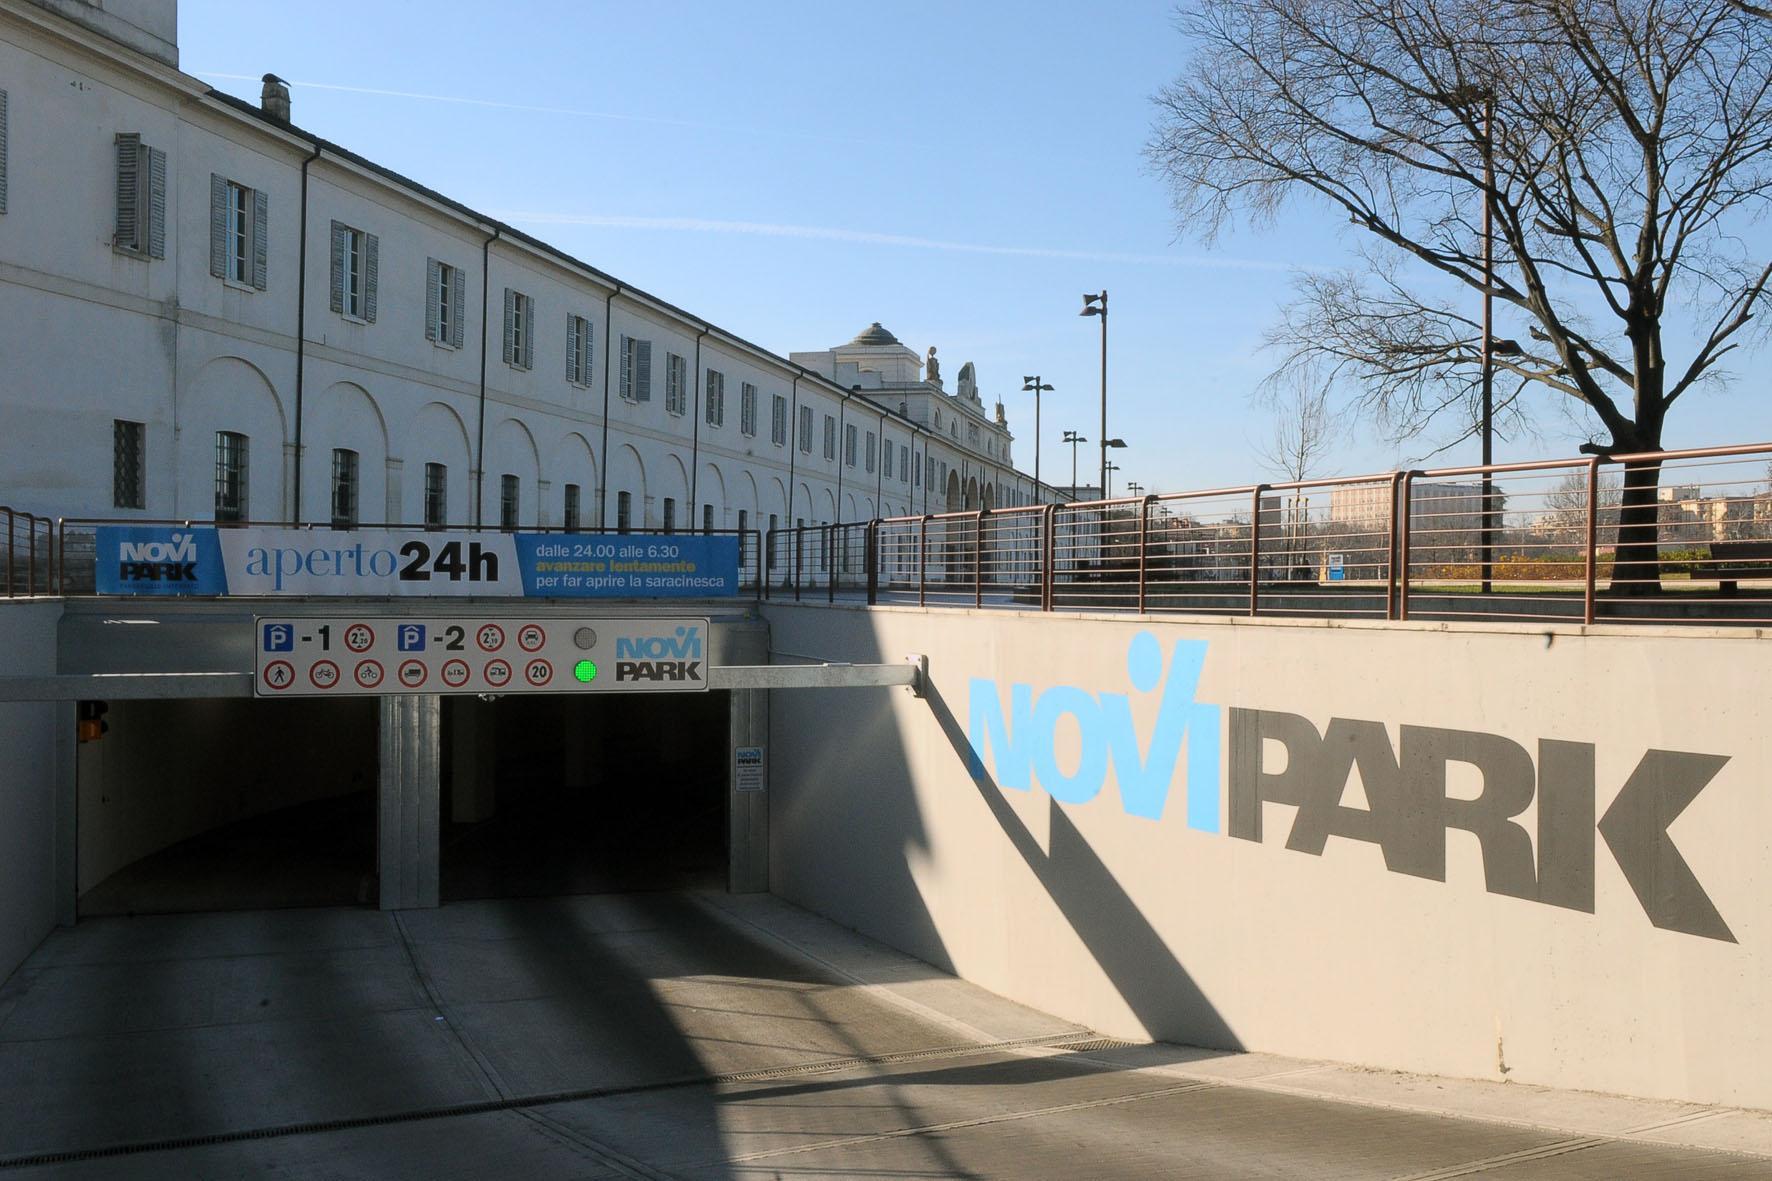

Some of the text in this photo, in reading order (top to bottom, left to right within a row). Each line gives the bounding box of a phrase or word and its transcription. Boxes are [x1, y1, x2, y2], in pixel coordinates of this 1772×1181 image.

[119, 533, 197, 561] NOVI
[536, 544, 679, 558] dalle 24.00 alle 6.30
[119, 562, 198, 581] PARK
[245, 541, 499, 591] aperto 24h
[536, 560, 697, 573] avanzare lentamente
[536, 574, 725, 589] per far aprire la saracinesca
[615, 626, 701, 659] NOVI
[532, 665, 548, 679] 20
[615, 661, 702, 681] PARK
